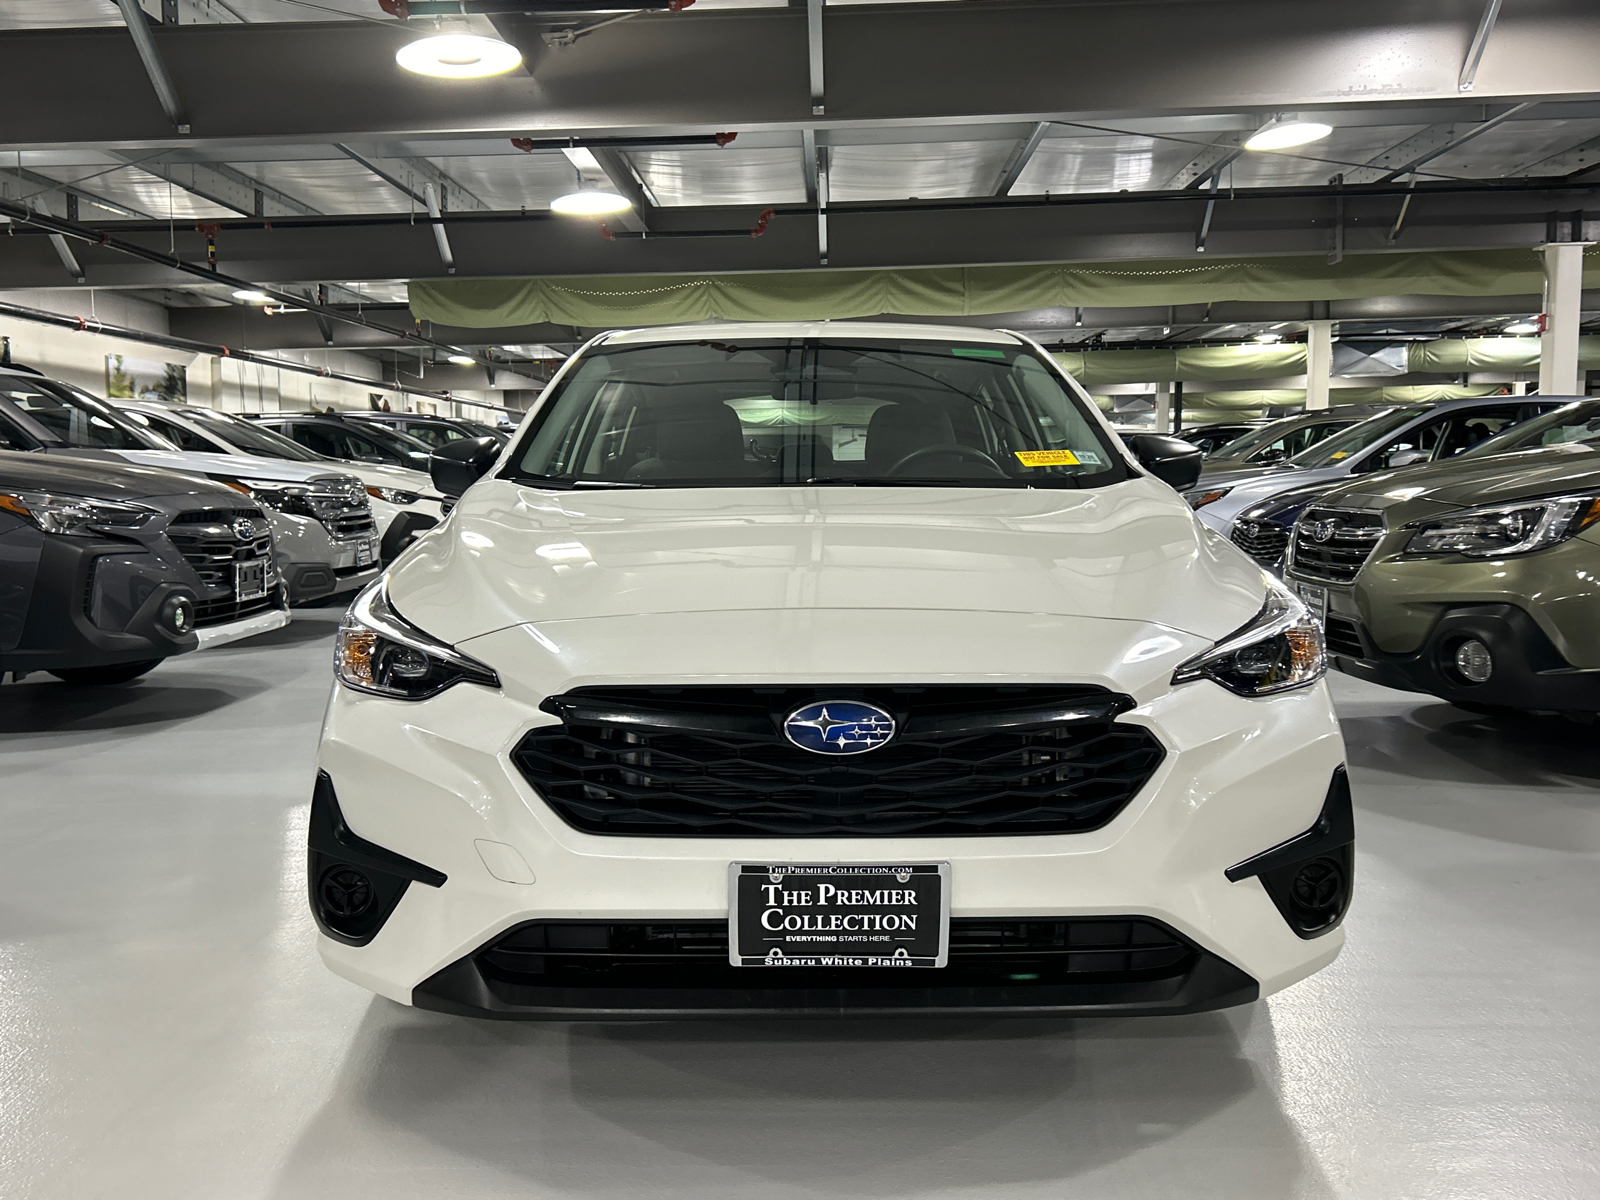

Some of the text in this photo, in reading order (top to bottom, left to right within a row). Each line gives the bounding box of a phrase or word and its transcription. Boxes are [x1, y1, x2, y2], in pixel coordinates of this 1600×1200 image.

[761, 884, 918, 906] THE PREMIER
[761, 909, 918, 931] COLLECTION
[764, 957, 913, 967] Subaru White Plains
